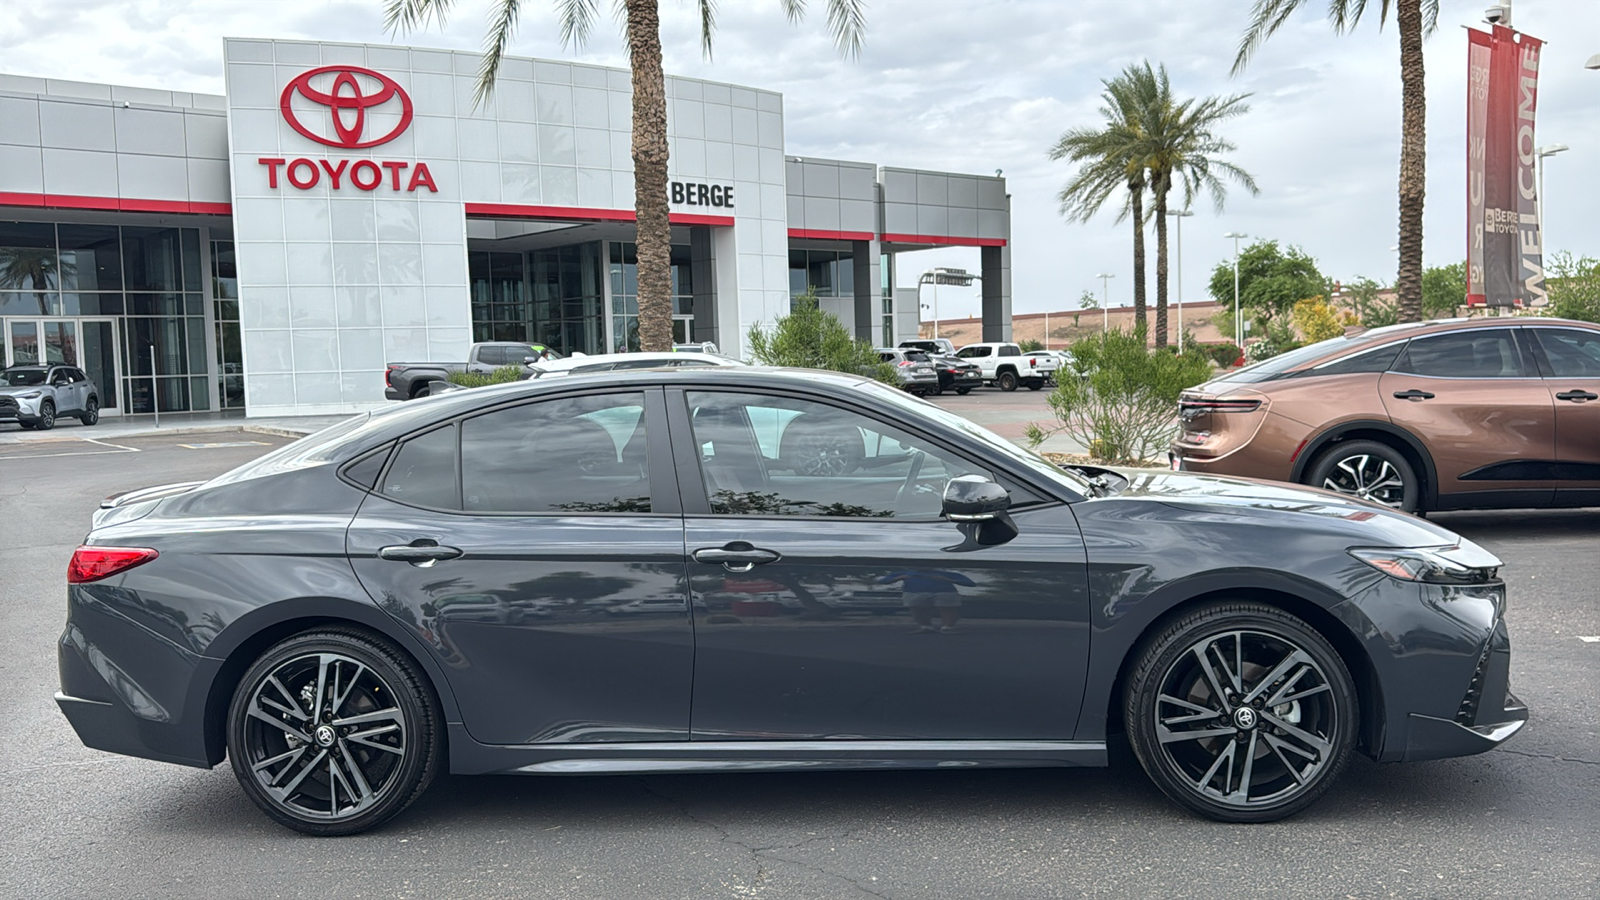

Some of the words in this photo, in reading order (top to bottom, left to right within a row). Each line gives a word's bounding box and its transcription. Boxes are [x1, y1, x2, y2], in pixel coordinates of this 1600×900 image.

[258, 157, 438, 192] TOYOTA
[1517, 43, 1548, 306] WELCOME
[671, 182, 735, 208] BERGE
[1494, 208, 1518, 223] BERE
[1495, 223, 1519, 235] TOYOA
